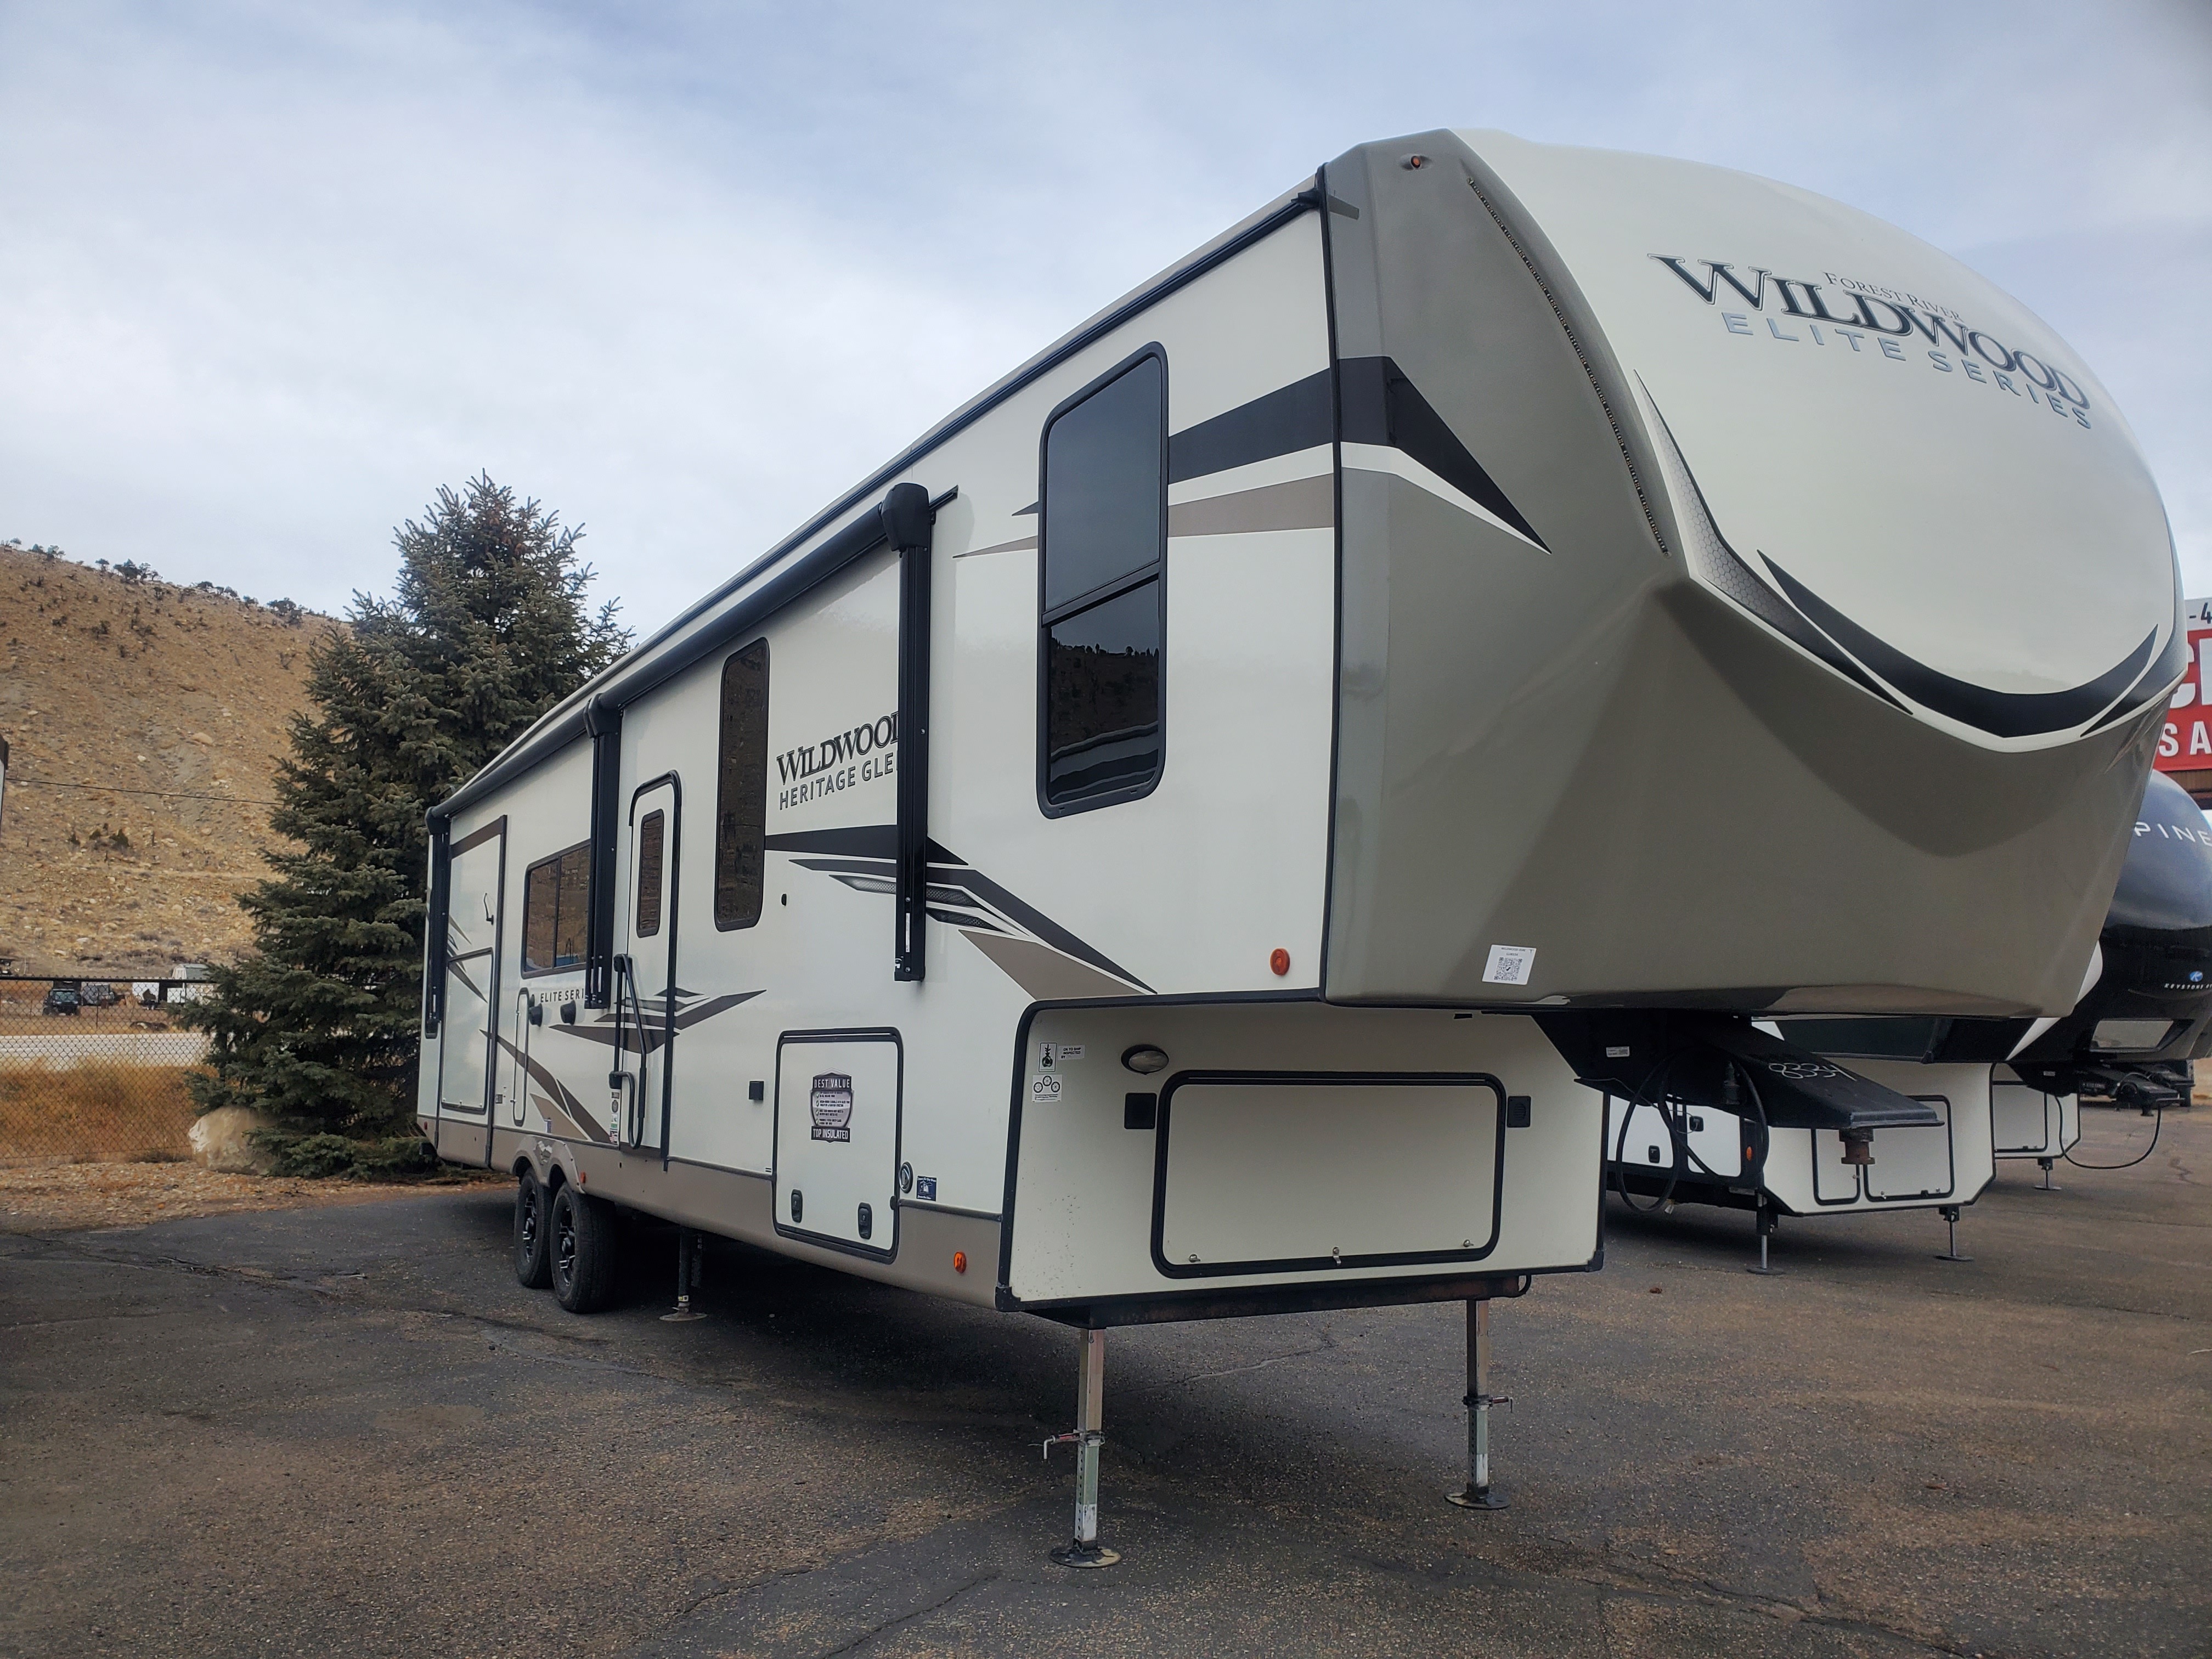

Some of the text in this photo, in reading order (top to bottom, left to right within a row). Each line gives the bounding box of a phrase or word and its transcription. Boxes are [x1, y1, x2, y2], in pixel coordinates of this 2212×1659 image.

[1823, 271, 1964, 324] FOREST RIVER
[1647, 253, 2091, 410] WILDWOOD
[1720, 312, 2092, 430] ELITE SERIES
[780, 751, 898, 811] HERITAGE GLE
[2134, 822, 2212, 846] PINE
[540, 991, 562, 1003] ELITE
[814, 1079, 850, 1088] BEST VALUE
[1769, 1063, 1857, 1081] 8334
[813, 1128, 848, 1139] TOP INSULATED
